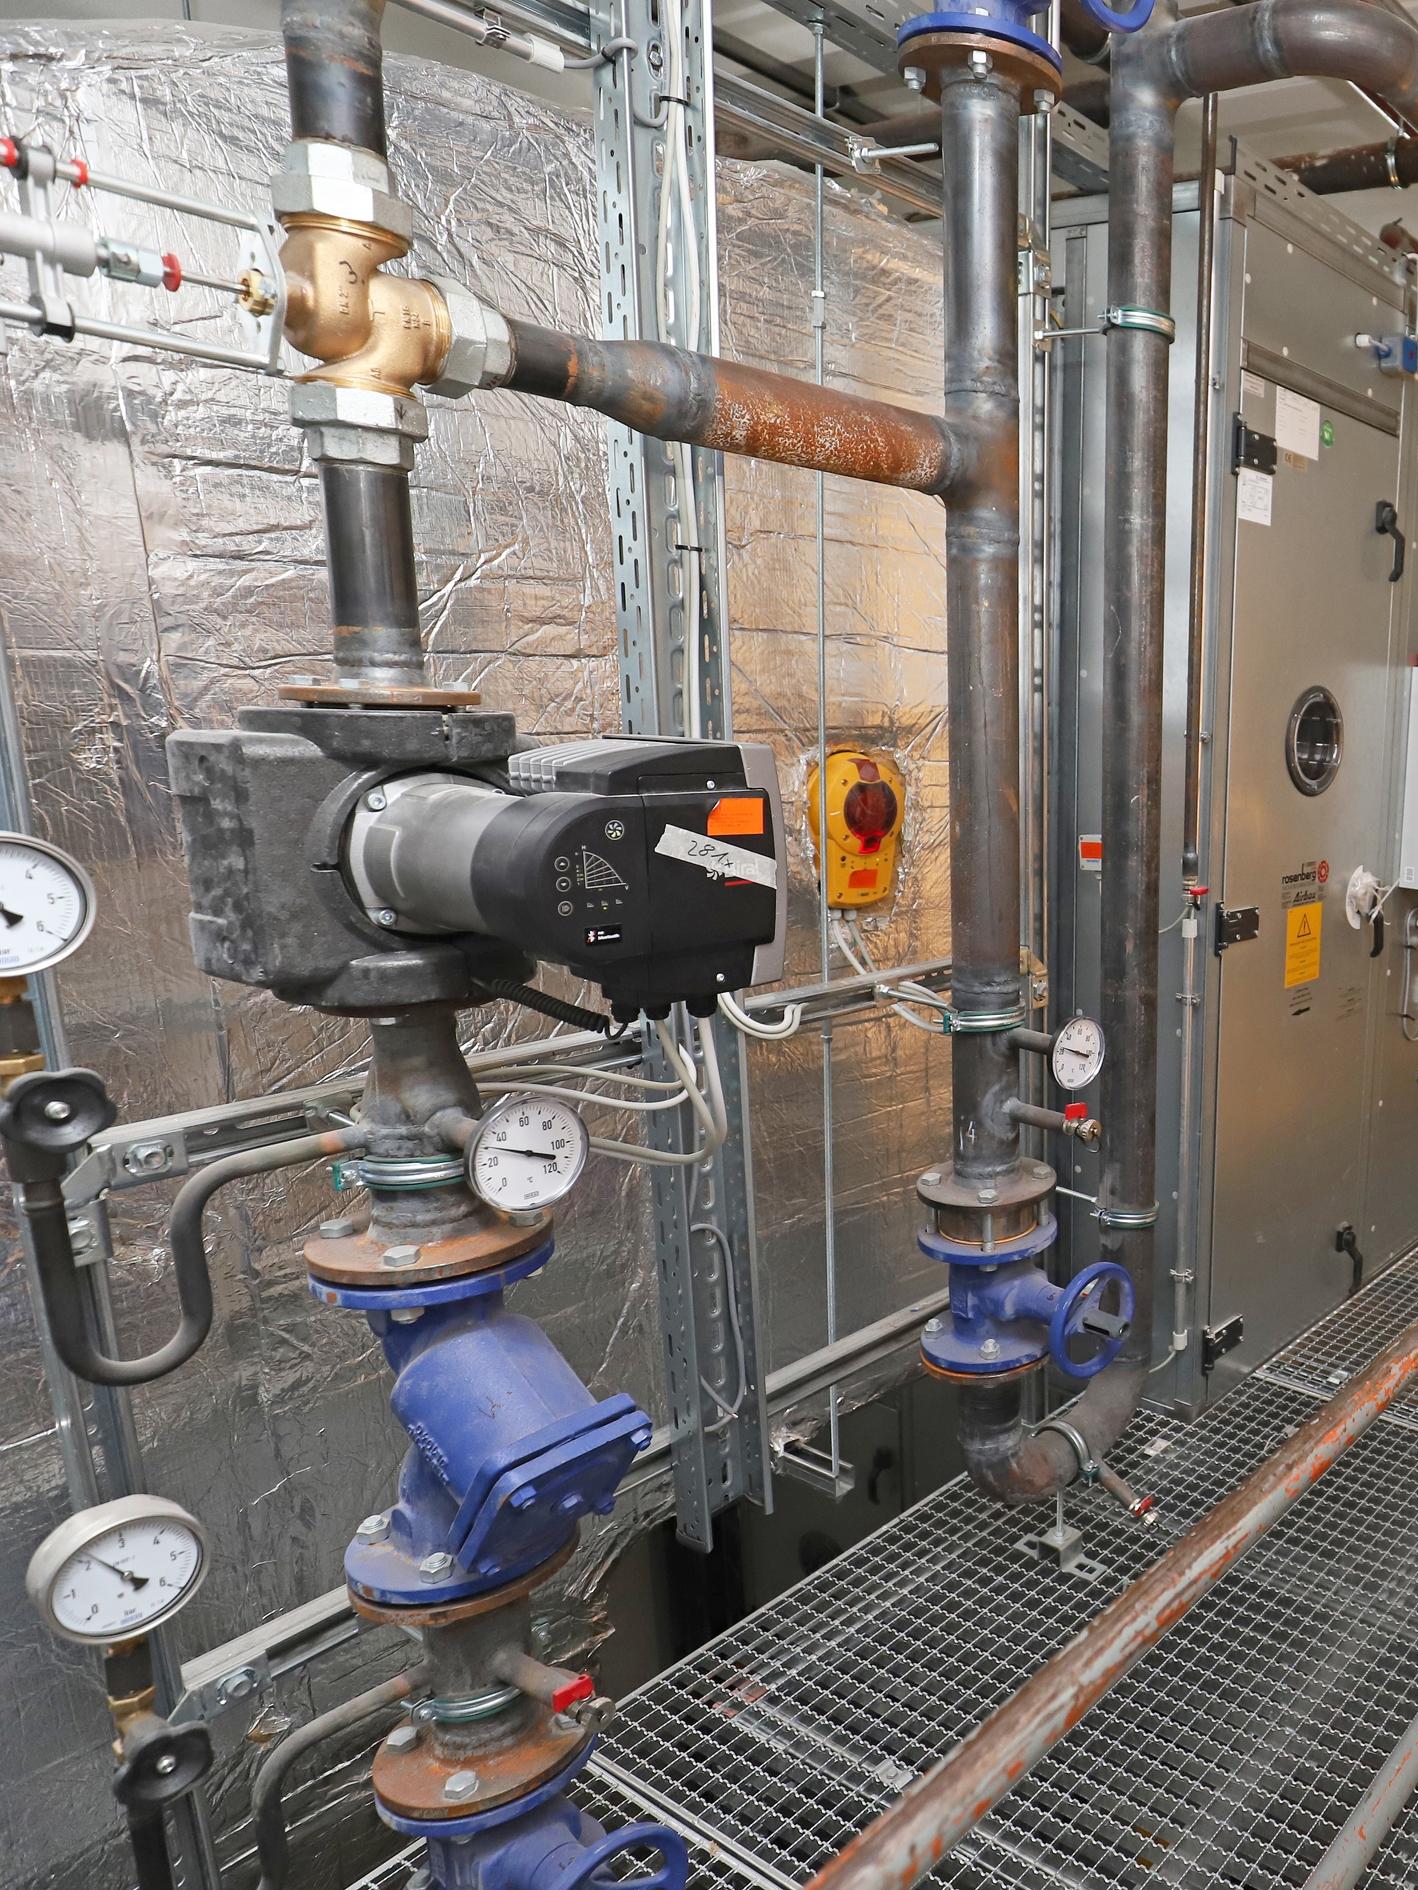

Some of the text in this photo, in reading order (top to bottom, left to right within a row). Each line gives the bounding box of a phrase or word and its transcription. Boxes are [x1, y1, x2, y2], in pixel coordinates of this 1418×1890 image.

[25, 868, 34, 880] 4
[1282, 863, 1316, 884] rosenberg
[46, 892, 56, 905] 5
[36, 920, 45, 933] 6
[519, 1116, 529, 1127] 60
[542, 1120, 552, 1131] 80
[496, 1131, 507, 1142] 40
[551, 1139, 565, 1150] 100
[487, 1156, 499, 1168] 20
[543, 1162, 558, 1174] 120
[501, 1177, 508, 1188] 0
[118, 1536, 126, 1549] 3
[153, 1536, 160, 1545] 4
[170, 1551, 177, 1562] 5
[158, 1576, 166, 1588] 6
[71, 1588, 76, 1599] 1
[91, 1603, 99, 1615] 0
